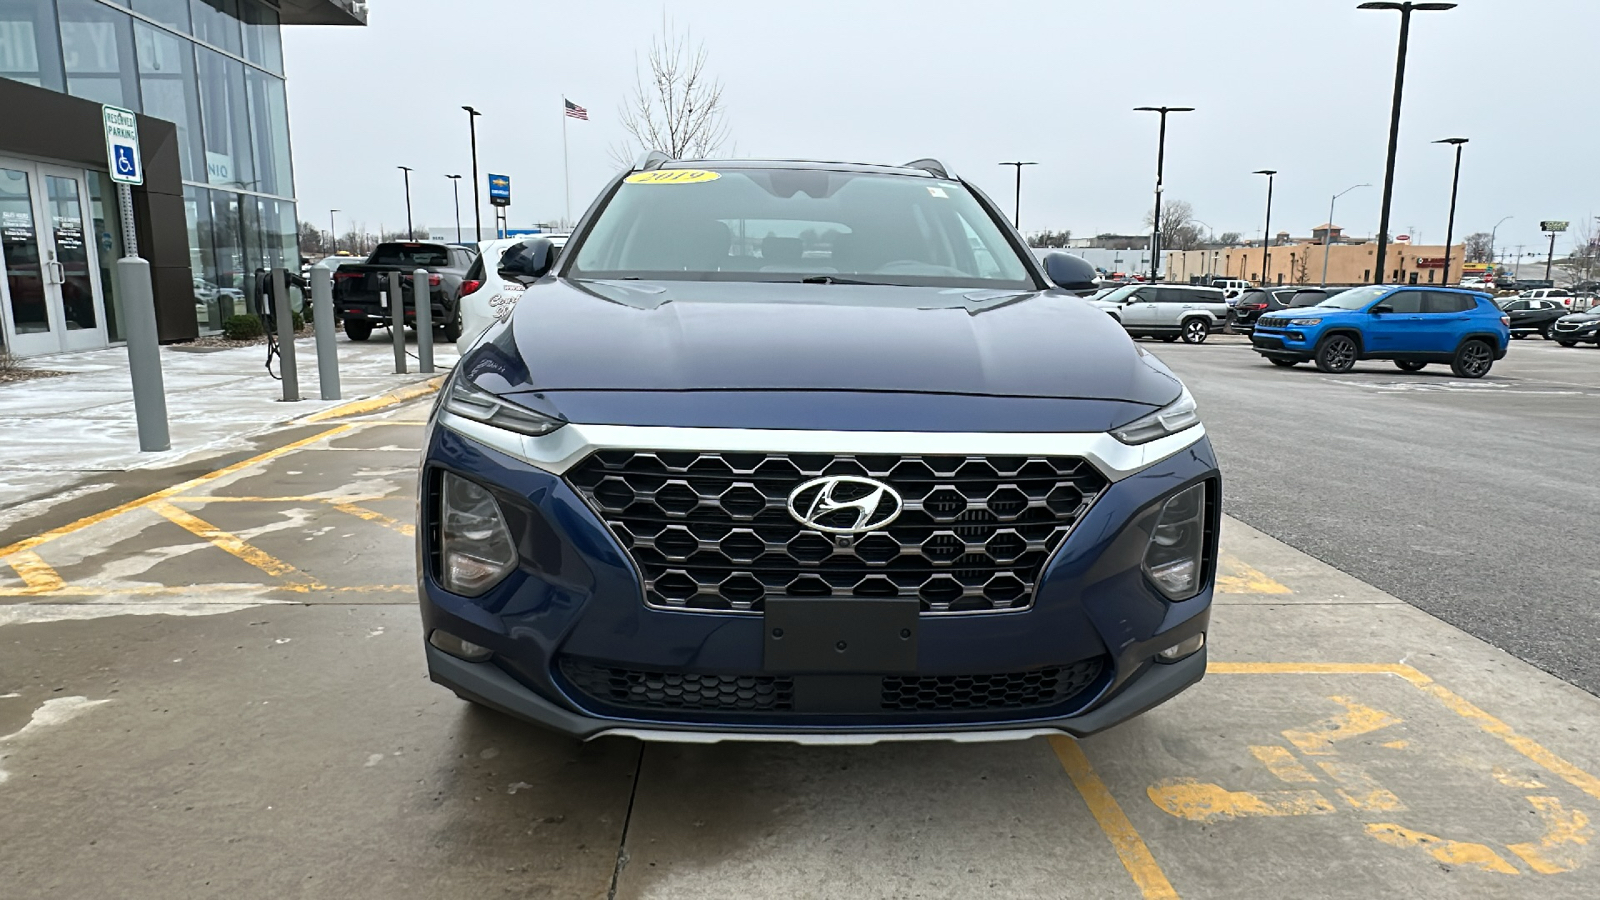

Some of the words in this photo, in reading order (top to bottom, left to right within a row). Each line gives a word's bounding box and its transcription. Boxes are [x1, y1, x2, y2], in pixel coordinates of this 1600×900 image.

[106, 113, 134, 127] RESERVED
[107, 126, 135, 140] PARKING
[637, 172, 705, 182] 2019
